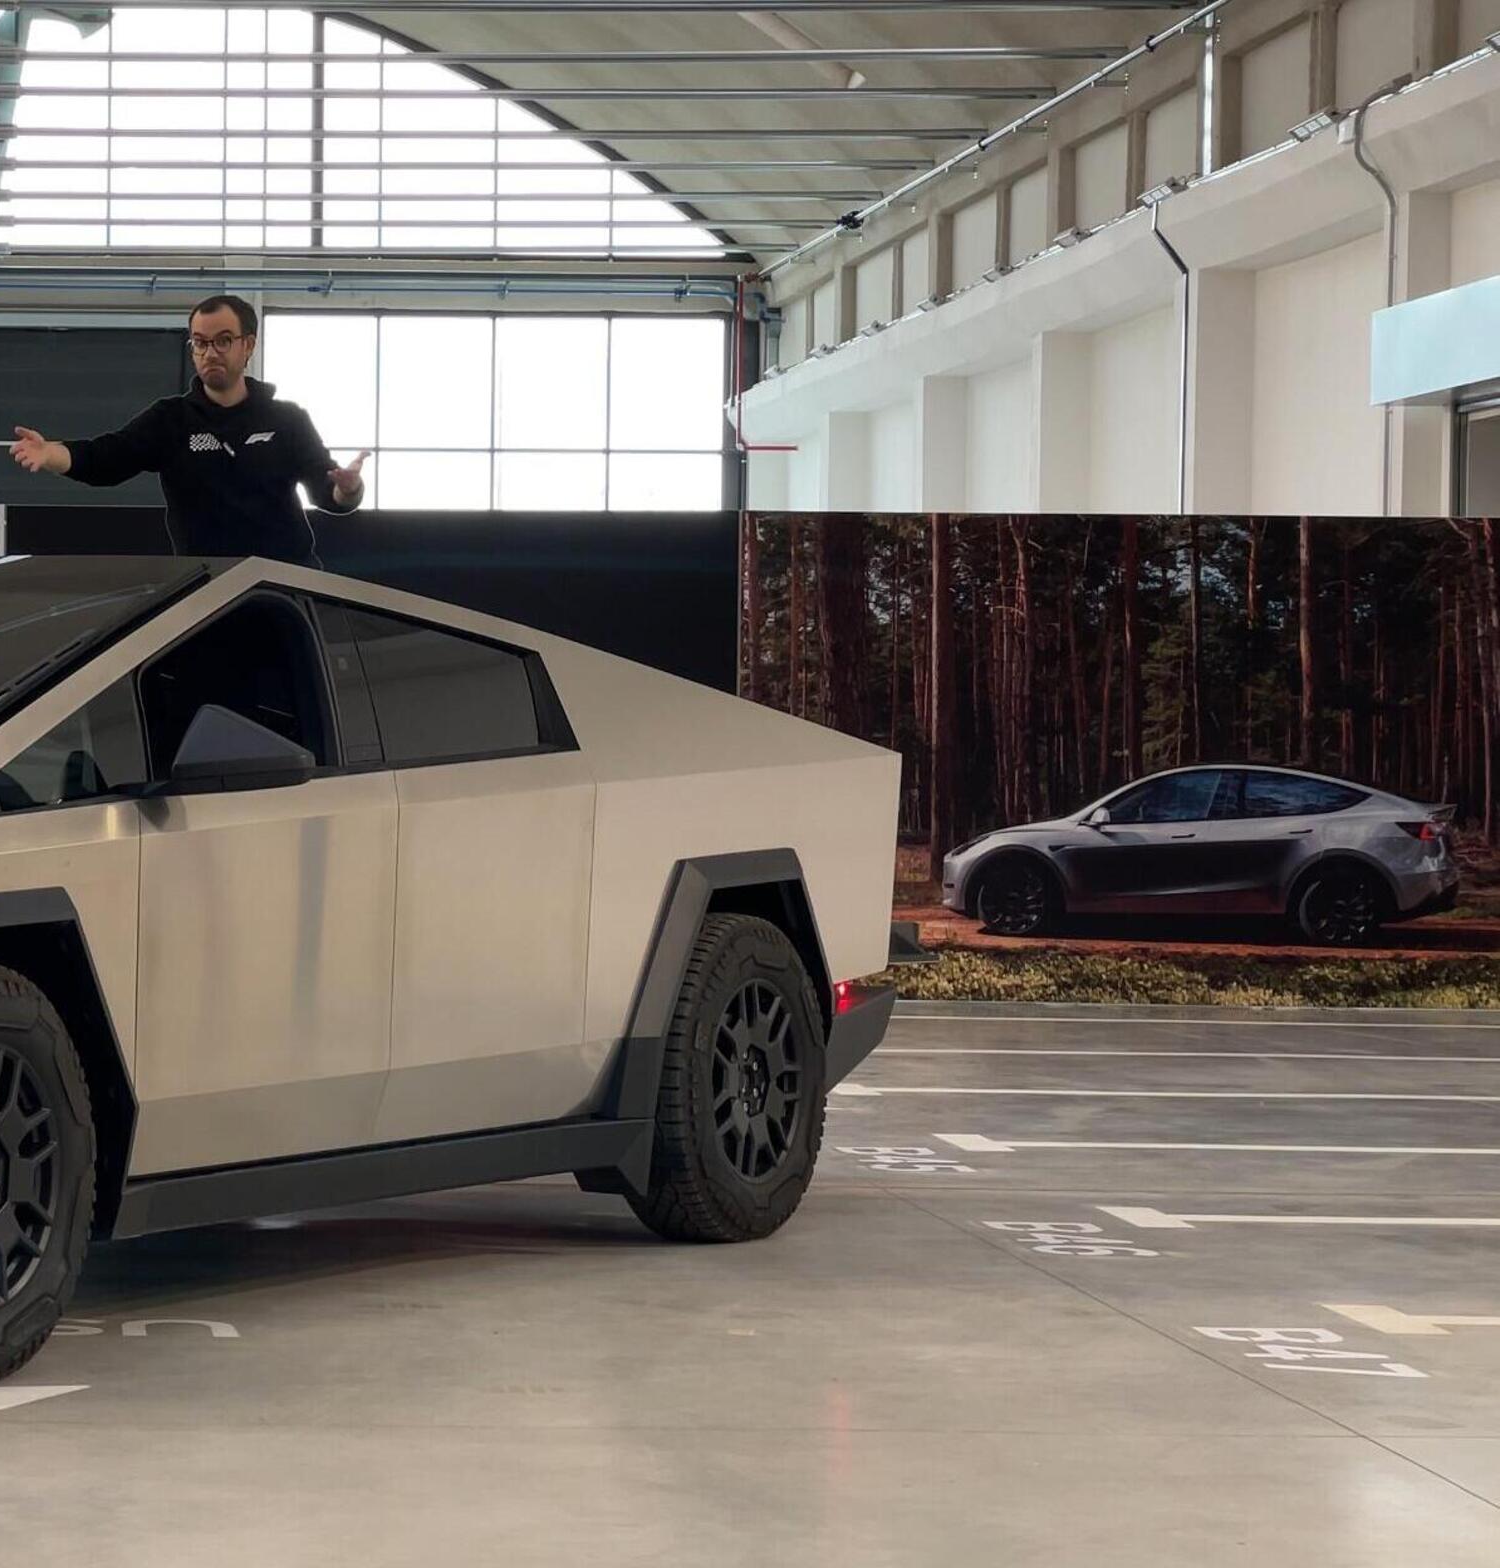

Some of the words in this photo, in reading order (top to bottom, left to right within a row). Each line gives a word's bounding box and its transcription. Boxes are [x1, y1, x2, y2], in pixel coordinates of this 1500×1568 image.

[835, 1146, 978, 1173] B45
[981, 1221, 1161, 1257] B46
[1191, 1326, 1432, 1378] B47
